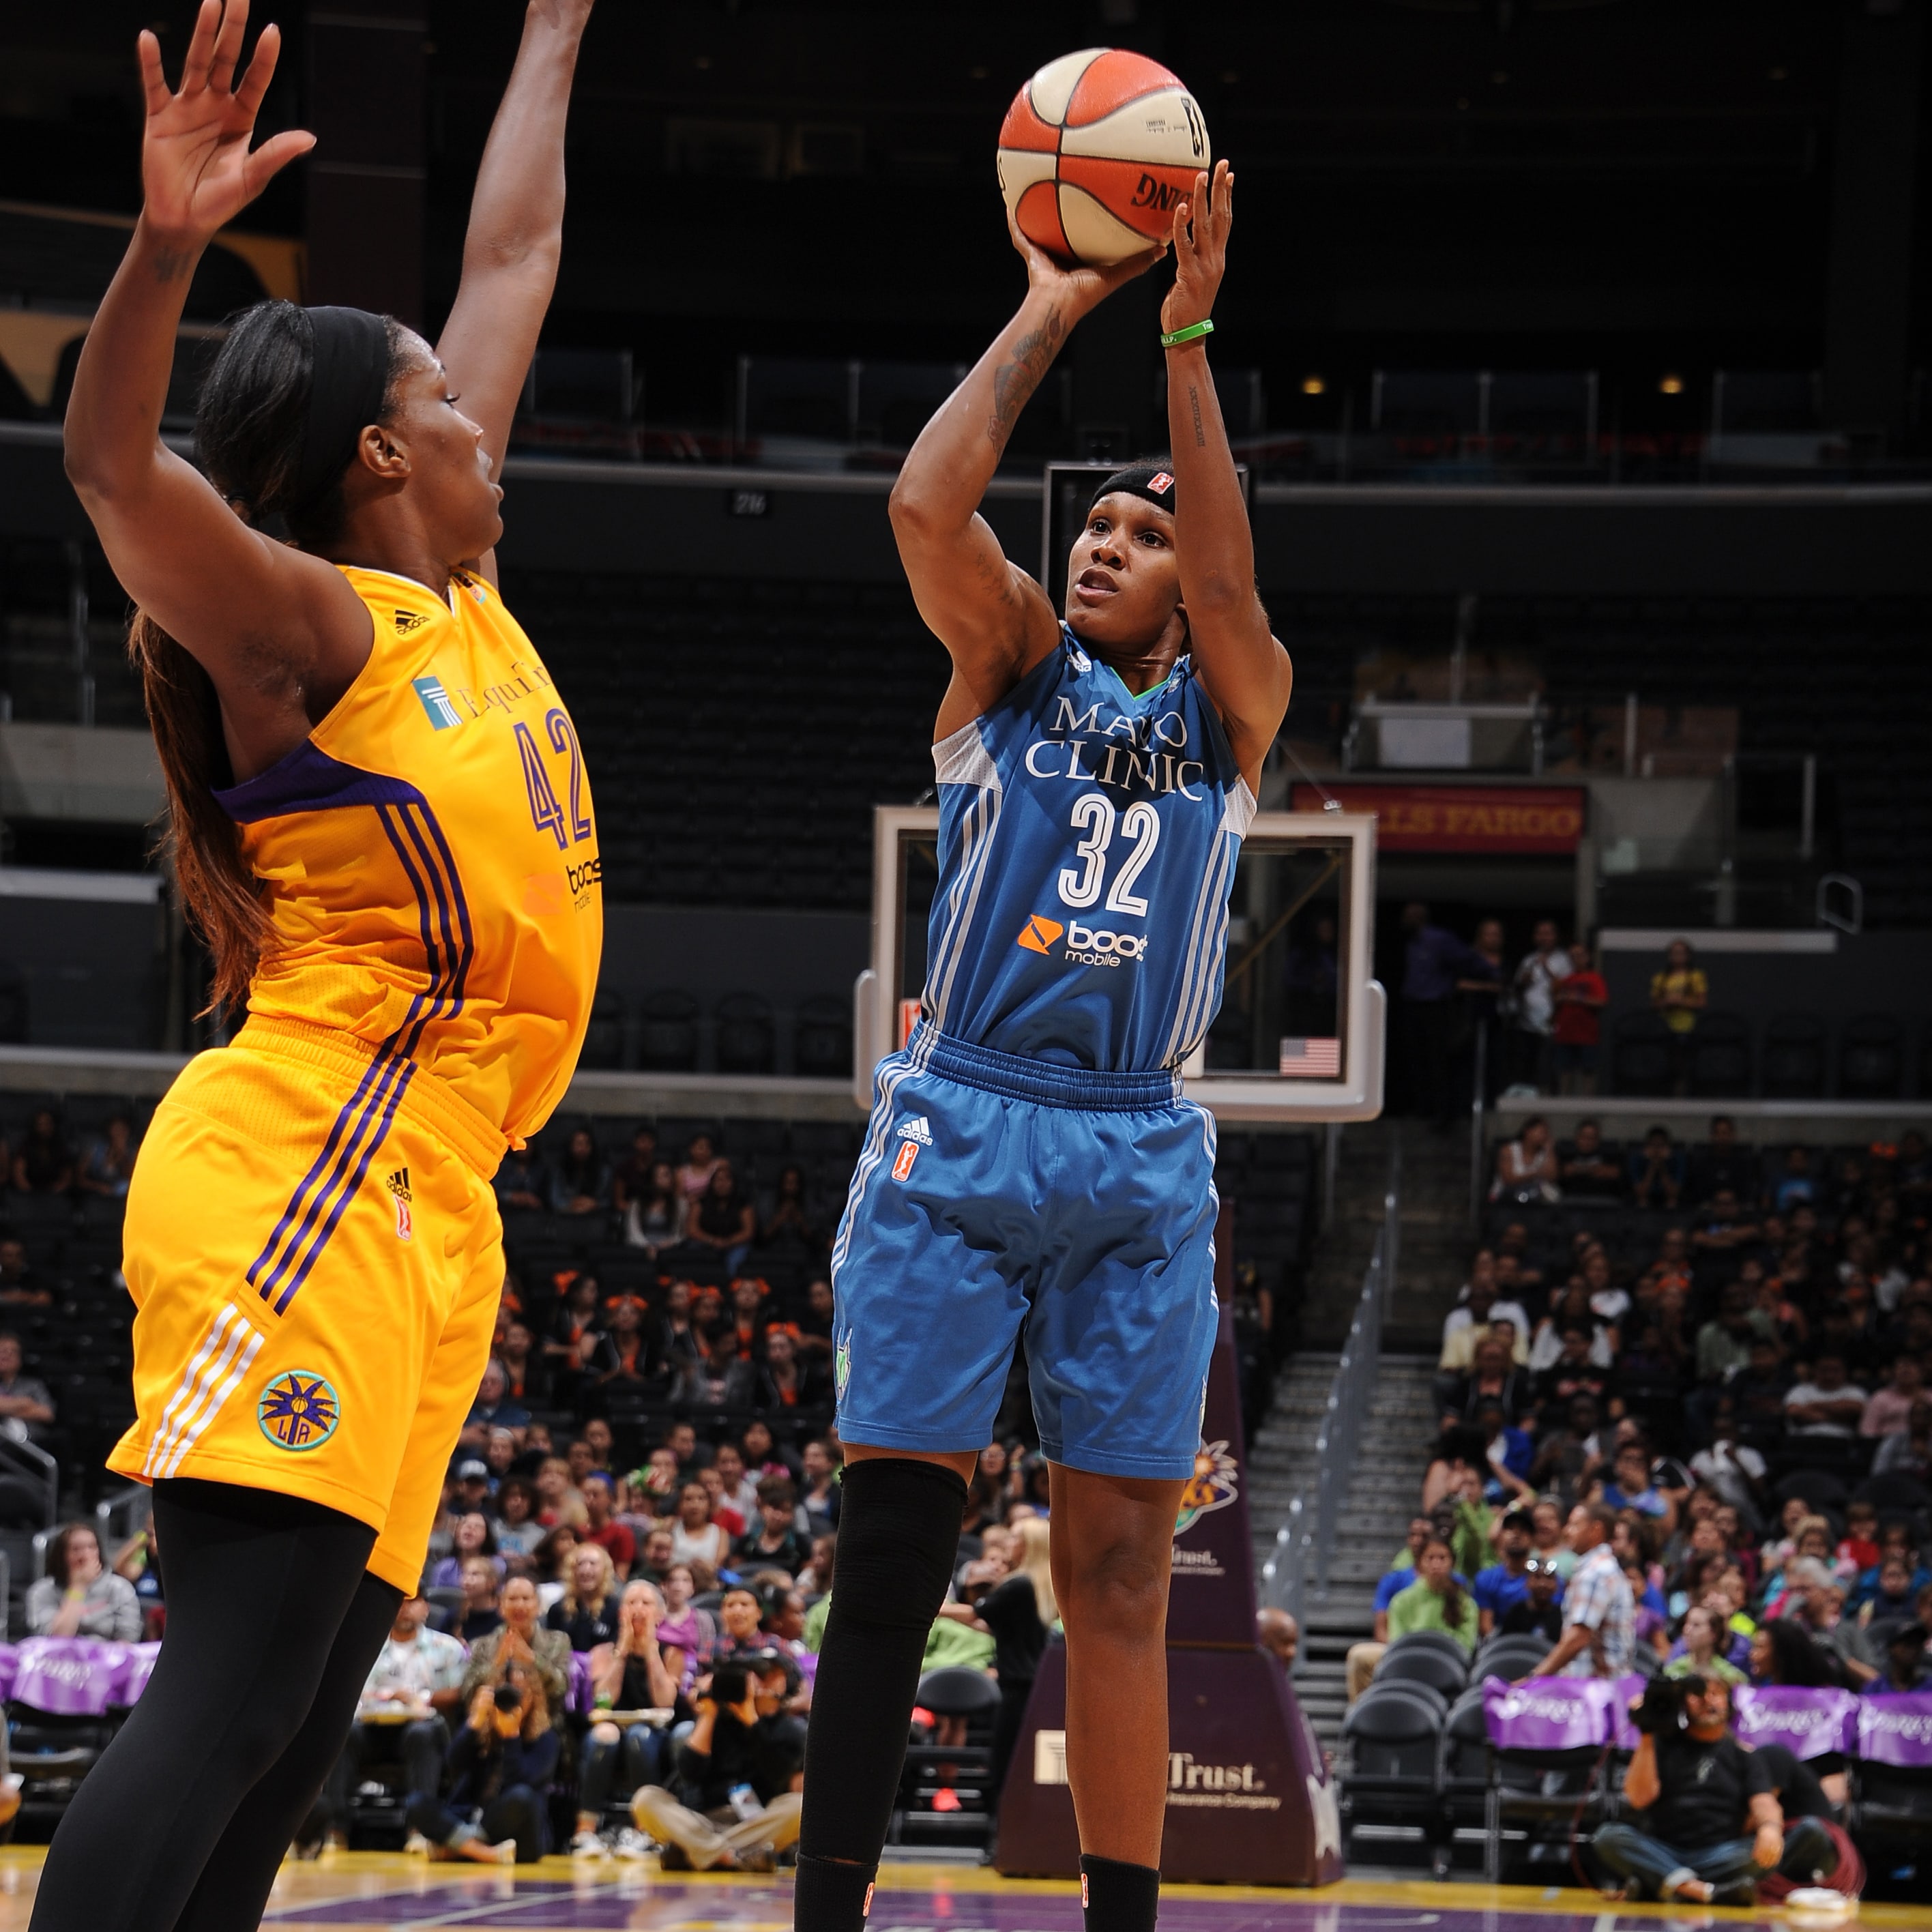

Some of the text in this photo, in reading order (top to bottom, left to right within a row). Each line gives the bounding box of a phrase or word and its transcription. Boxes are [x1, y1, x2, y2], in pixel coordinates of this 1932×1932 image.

[512, 707, 591, 851] 42
[1025, 740, 1204, 802] CLINIC
[1058, 793, 1160, 918] 32
[1064, 950, 1121, 967] mobile
[897, 1128, 933, 1146] adidas
[386, 1180, 412, 1202] adidas
[1168, 1753, 1265, 1791] Trust.
